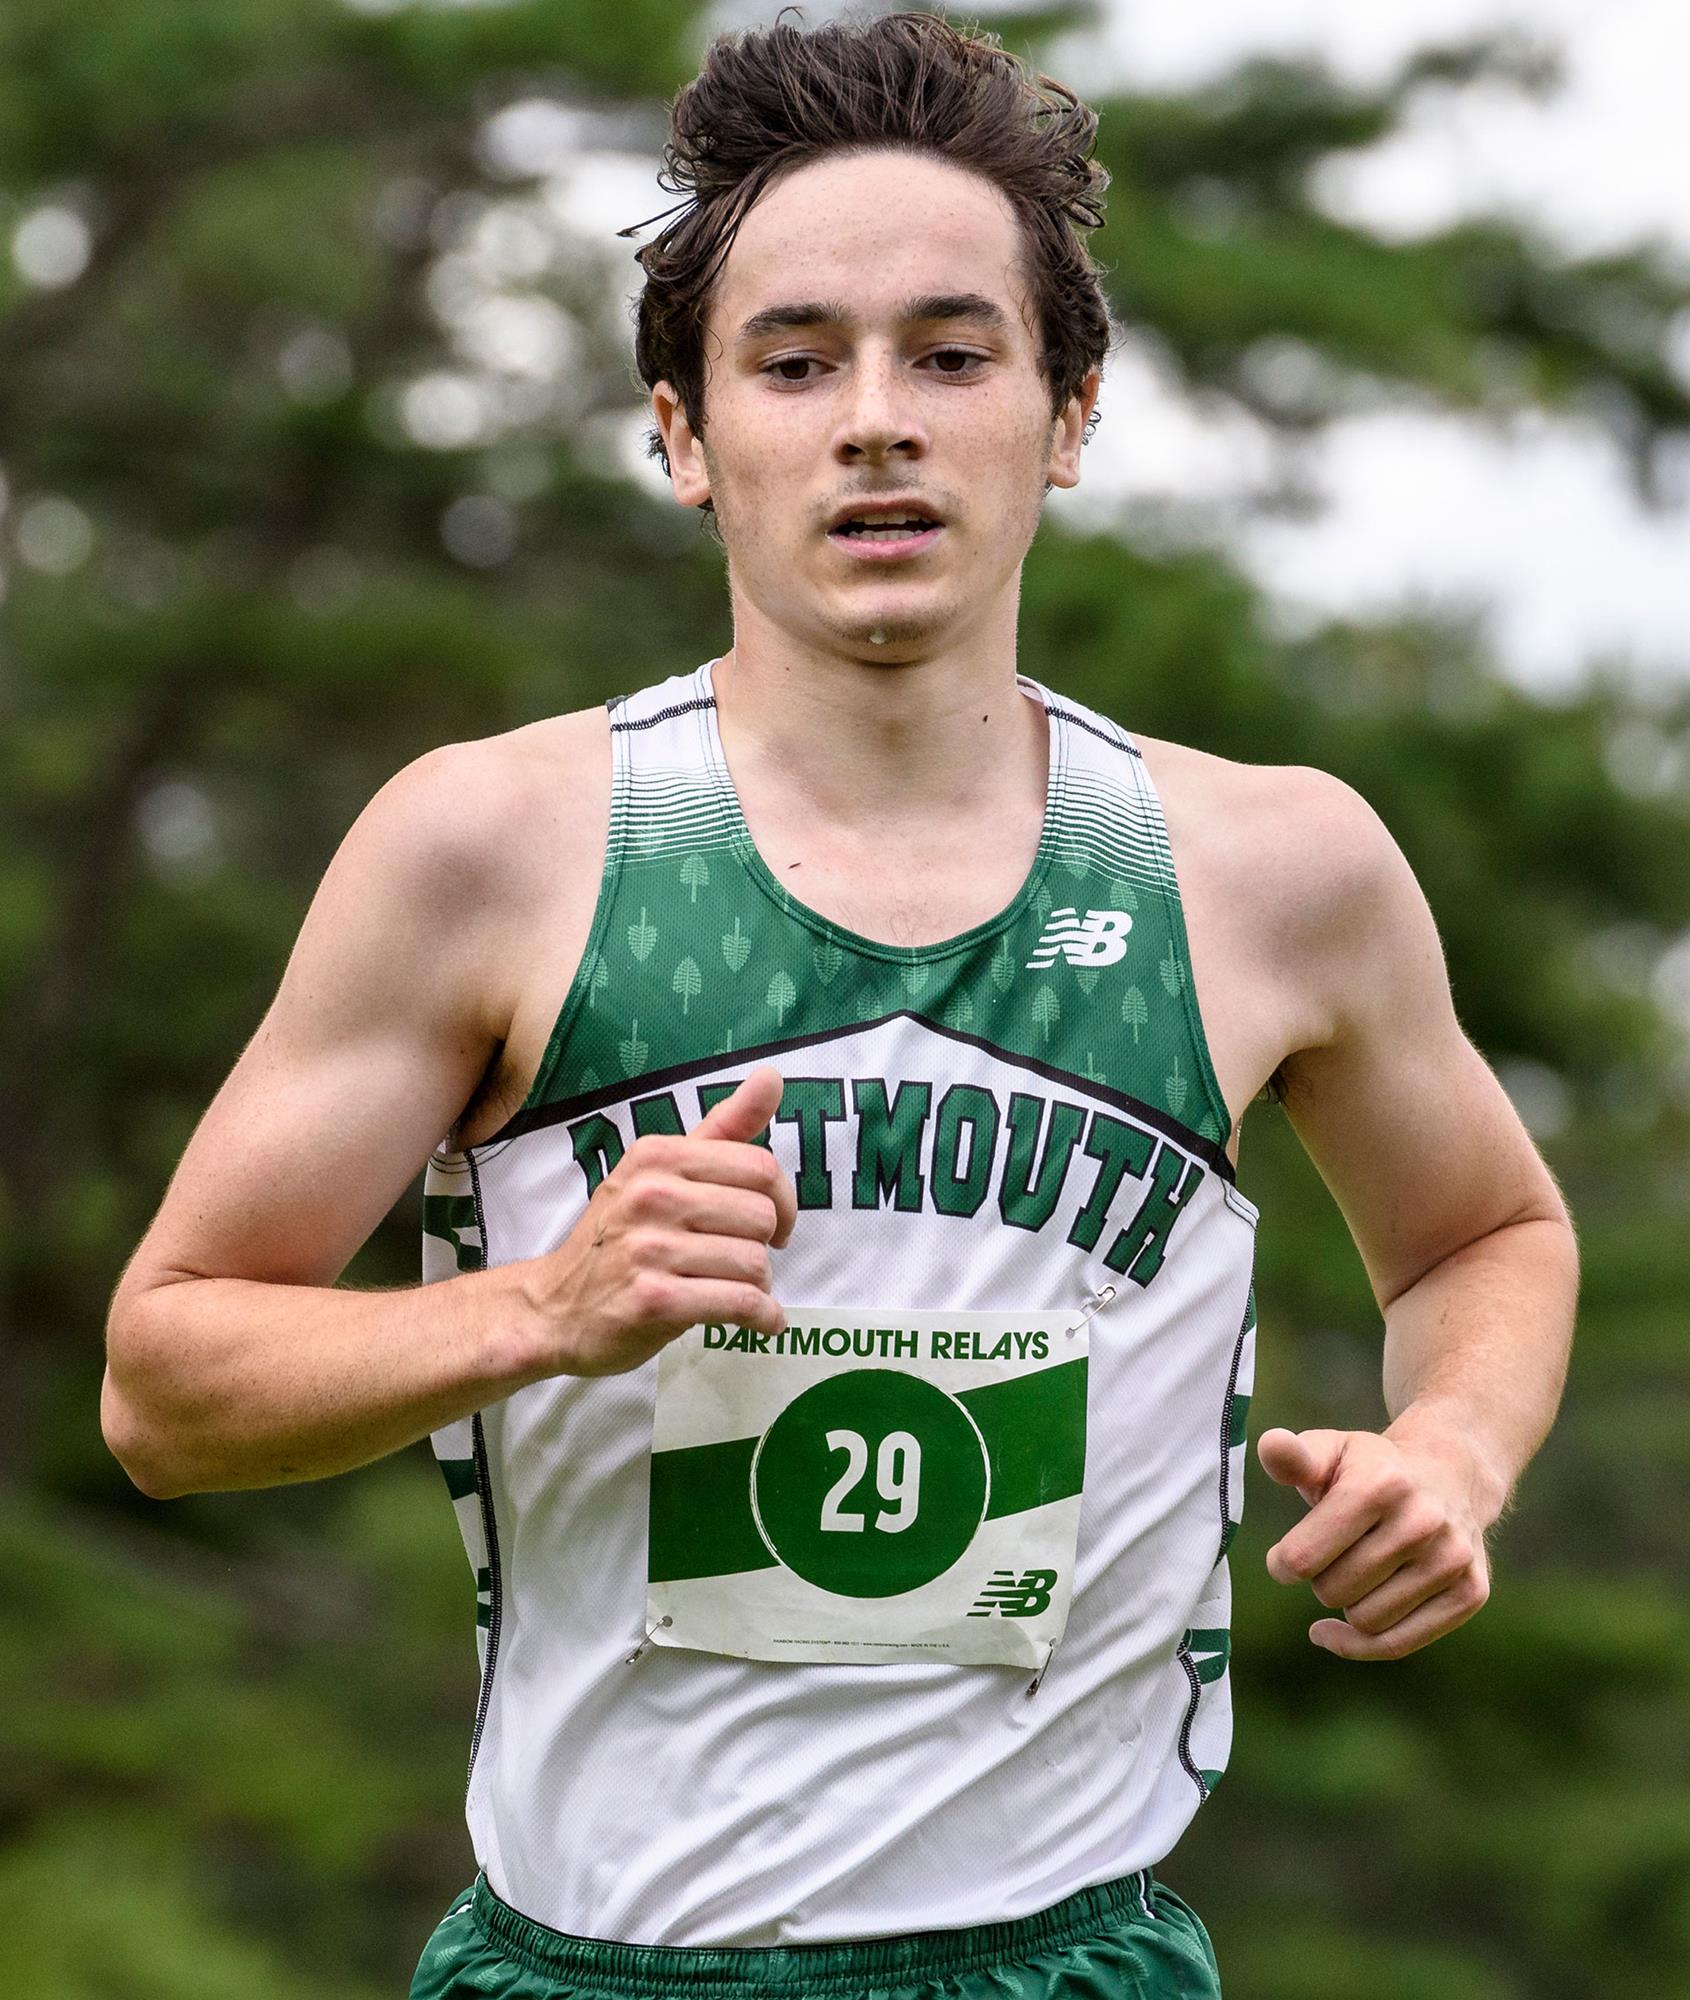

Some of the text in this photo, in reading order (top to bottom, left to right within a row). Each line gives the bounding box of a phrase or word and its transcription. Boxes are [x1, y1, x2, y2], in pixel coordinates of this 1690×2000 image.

[566, 1077, 1205, 1289] DTMOUTH
[931, 1330, 1049, 1360] RELAYS
[820, 1429, 922, 1534] 29
